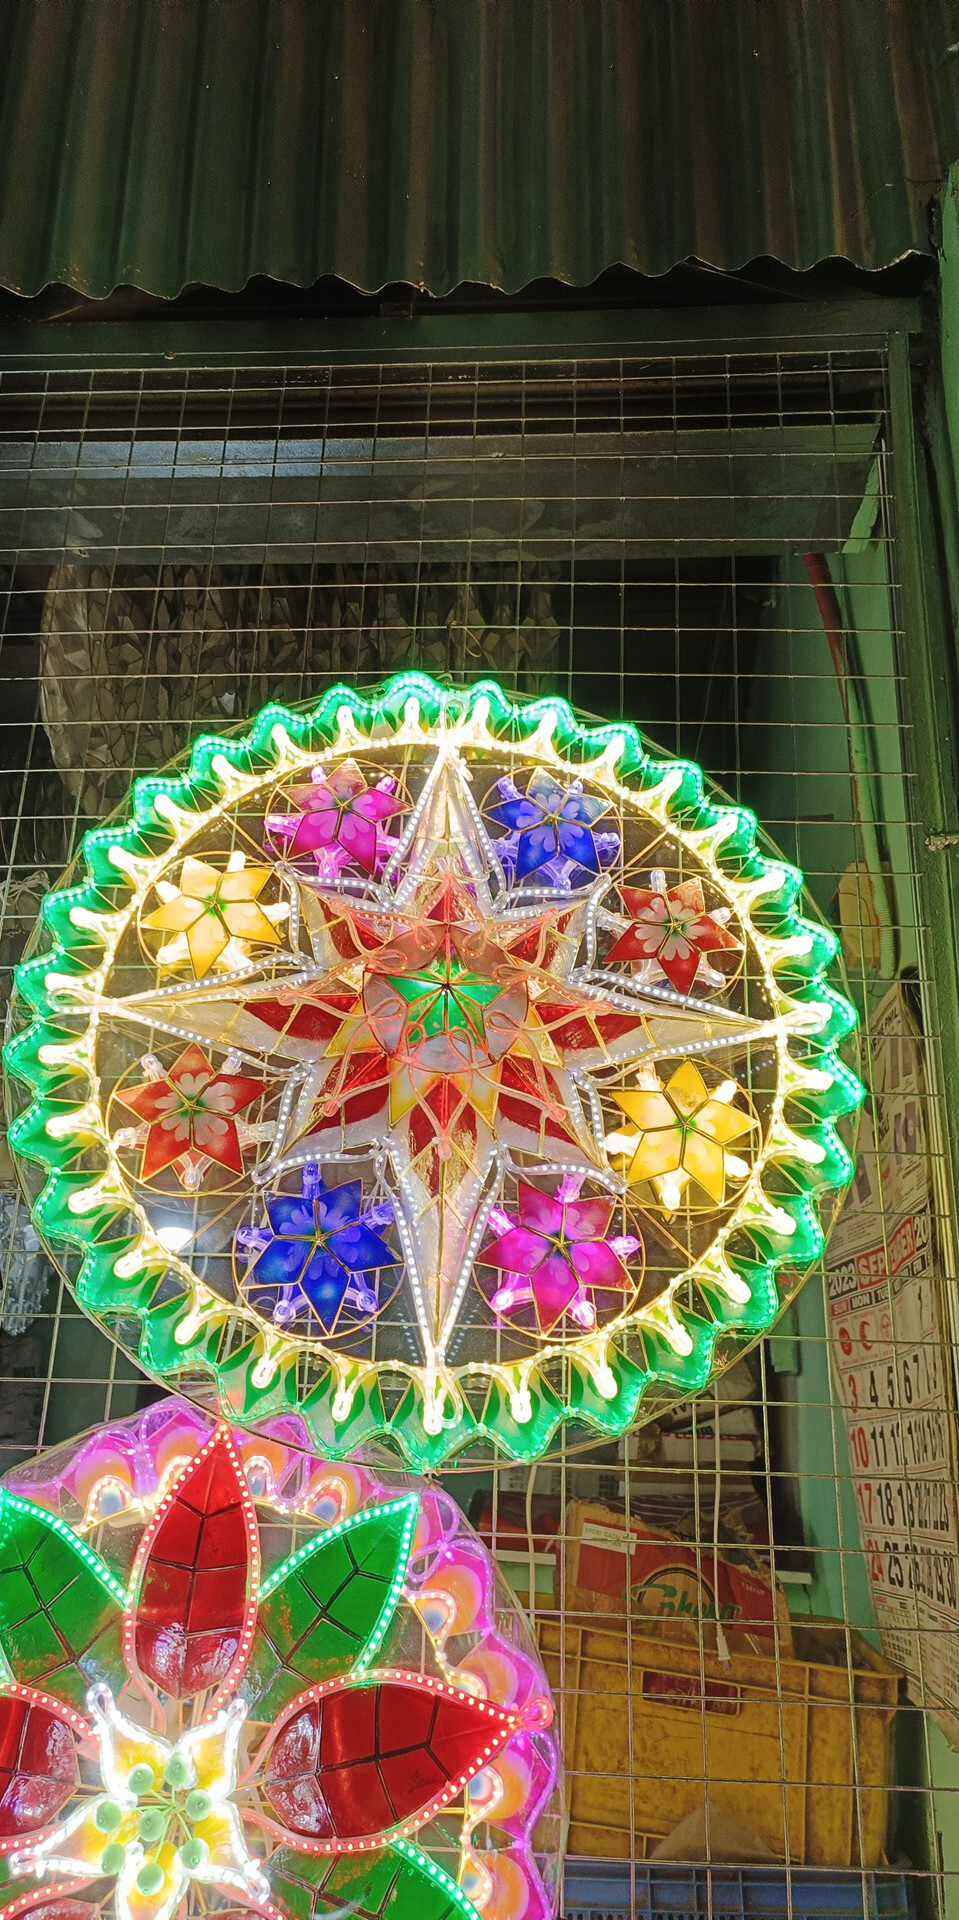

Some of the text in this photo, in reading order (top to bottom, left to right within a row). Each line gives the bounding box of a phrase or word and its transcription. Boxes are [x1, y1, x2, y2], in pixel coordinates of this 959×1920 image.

[848, 1374, 858, 1413] 3
[870, 1370, 879, 1407] 4
[886, 1365, 895, 1407] 5
[903, 1359, 912, 1404] 6
[851, 1426, 869, 1468] 10
[870, 1425, 888, 1467] 11
[858, 1482, 873, 1525] 17
[876, 1481, 895, 1527] 18
[883, 1540, 905, 1588] 25
